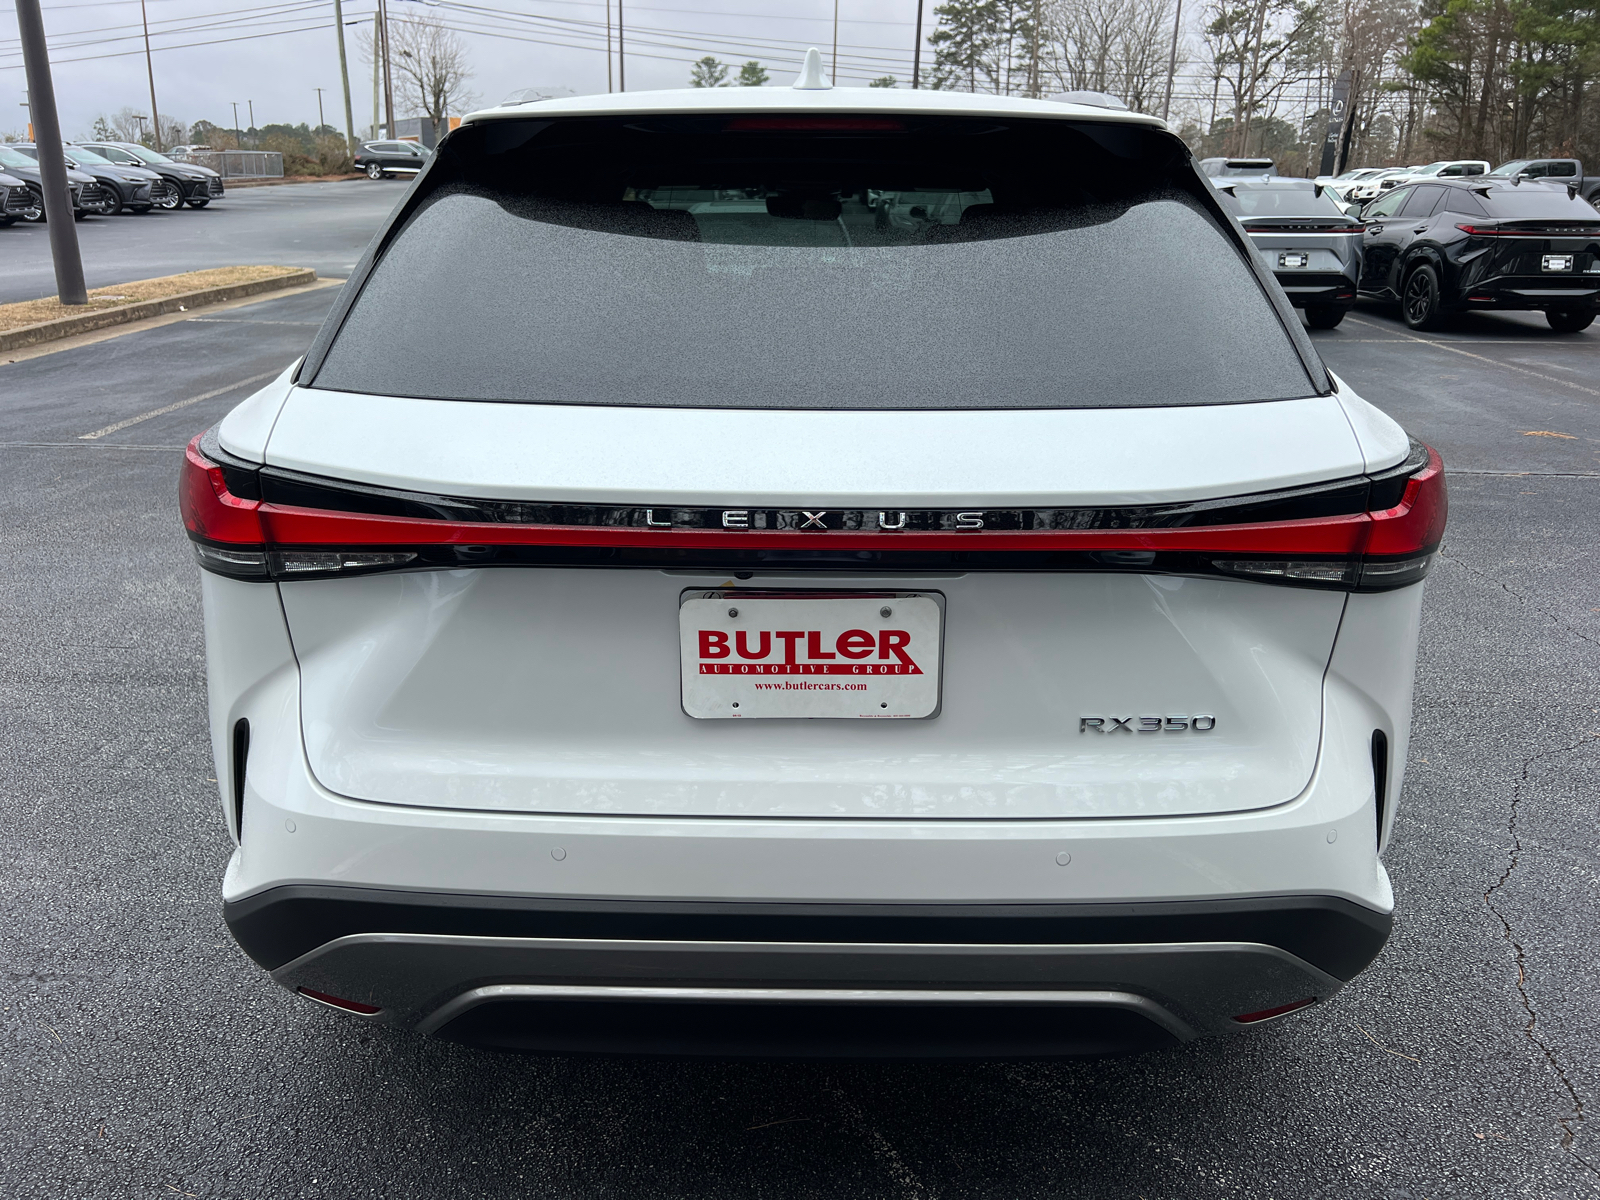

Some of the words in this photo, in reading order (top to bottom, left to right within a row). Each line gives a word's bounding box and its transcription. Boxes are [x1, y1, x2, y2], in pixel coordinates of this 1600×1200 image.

[646, 509, 984, 529] LEXUS
[701, 664, 830, 674] AUTOMOTIVE
[852, 664, 915, 674] GROUP
[754, 680, 868, 691] www.butlercars.com
[1079, 714, 1216, 733] RX350
